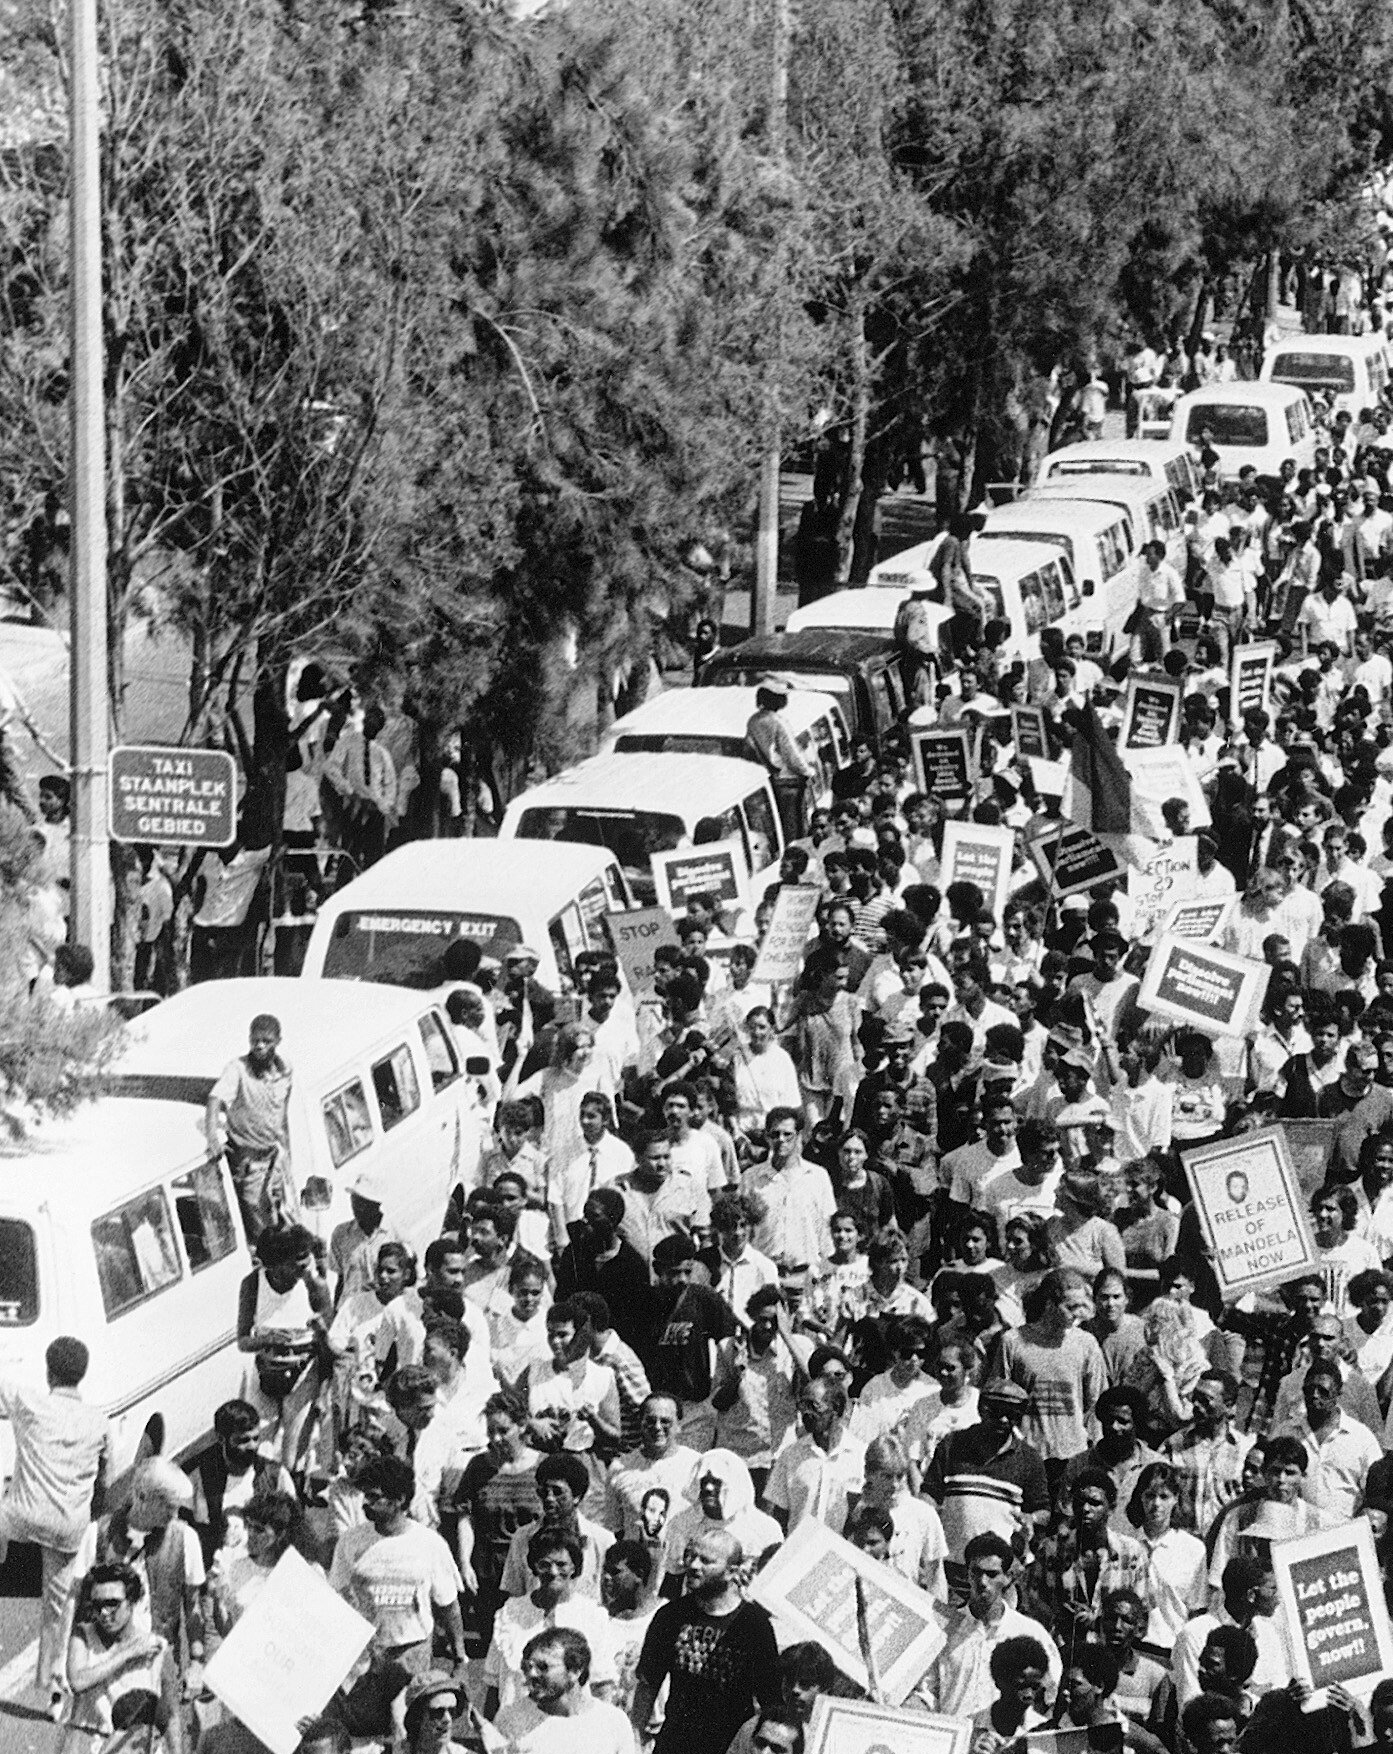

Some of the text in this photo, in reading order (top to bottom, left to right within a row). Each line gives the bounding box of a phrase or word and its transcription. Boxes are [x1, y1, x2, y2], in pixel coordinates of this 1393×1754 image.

[152, 758, 192, 776] TAXI
[120, 776, 226, 797] STAANPLEK
[124, 796, 221, 817] SENTRALE
[138, 816, 206, 835] GEBIED
[357, 916, 498, 938] EMERGENCY EXIT
[619, 921, 661, 942] STOP
[1213, 1194, 1287, 1225] RELEASE
[1245, 1218, 1265, 1235] OF
[1220, 1229, 1297, 1260] MANDELA
[1247, 1250, 1284, 1271] NOW
[1296, 1570, 1360, 1601] Let the
[1305, 1592, 1362, 1627] people
